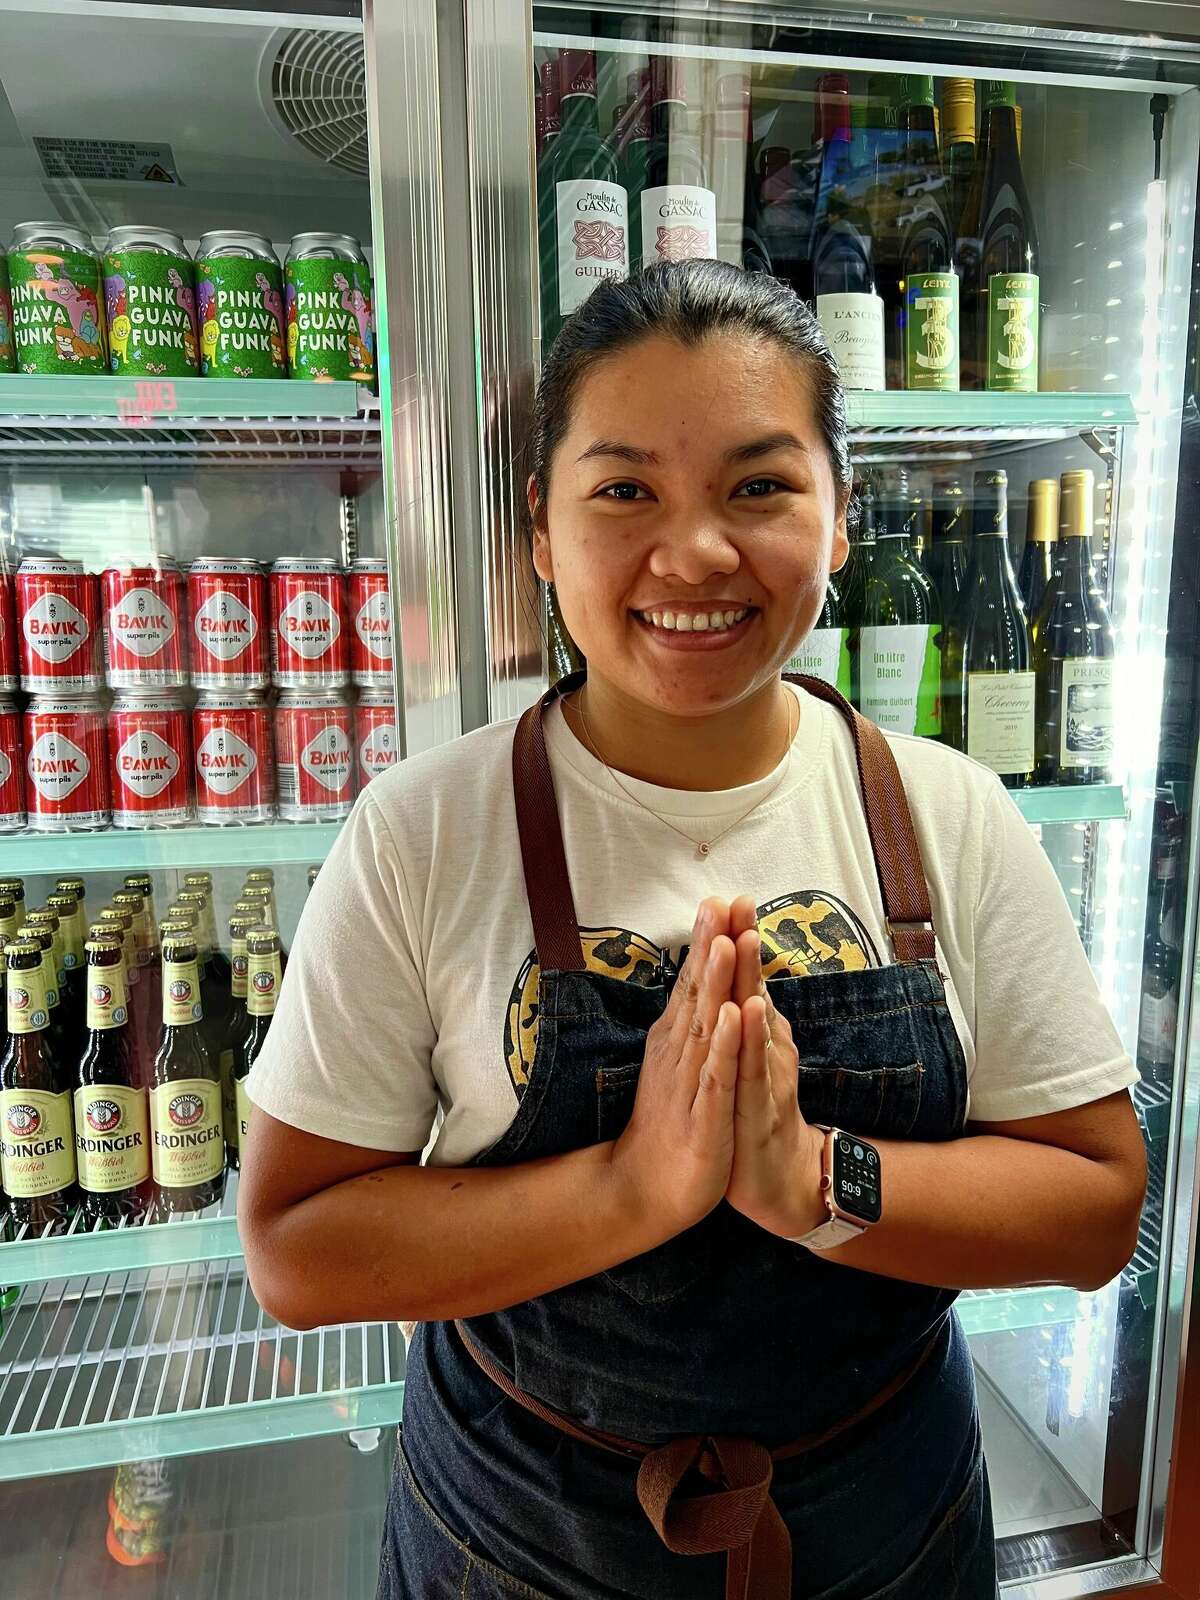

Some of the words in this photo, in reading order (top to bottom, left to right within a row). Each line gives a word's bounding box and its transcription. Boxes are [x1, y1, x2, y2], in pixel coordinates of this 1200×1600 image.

[576, 199, 622, 217] GASSAC
[659, 204, 705, 218] GASSAC
[11, 284, 45, 305] PINK
[129, 285, 176, 306] PINK
[217, 290, 264, 309] PINK
[298, 291, 341, 310] PINK
[13, 306, 67, 326] GUAVA
[131, 307, 192, 330] GUAVA
[219, 311, 279, 334] GUAVA
[299, 312, 358, 333] GUAVA
[15, 327, 54, 348] FUNK
[132, 329, 184, 349] FUNK
[220, 333, 271, 351] FUNK
[300, 333, 347, 351] FUNK
[29, 619, 81, 636] BAVIK
[117, 614, 169, 630] BAVIK
[200, 617, 250, 633] BAVIK
[286, 617, 331, 633] BAVIK
[38, 638, 57, 647] super
[59, 637, 72, 647] pils
[126, 632, 146, 641] super
[148, 631, 160, 641] pils
[229, 634, 241, 645] pils
[294, 635, 314, 644] super
[314, 634, 326, 643] pils
[873, 652, 884, 664] Un
[886, 652, 905, 663] litre
[877, 667, 902, 679] Blanc
[879, 713, 900, 722] France
[32, 758, 81, 773] BAVIK
[121, 755, 172, 771] BAVIK
[200, 752, 249, 768] BAVIK
[310, 750, 351, 766] BAVIK
[58, 775, 72, 785] pils
[130, 774, 150, 782] super
[150, 772, 163, 781] pils
[208, 771, 226, 780] super
[226, 770, 239, 779] pils
[76, 1132, 143, 1154] ERDINGER
[155, 1125, 221, 1149] ERDINGER
